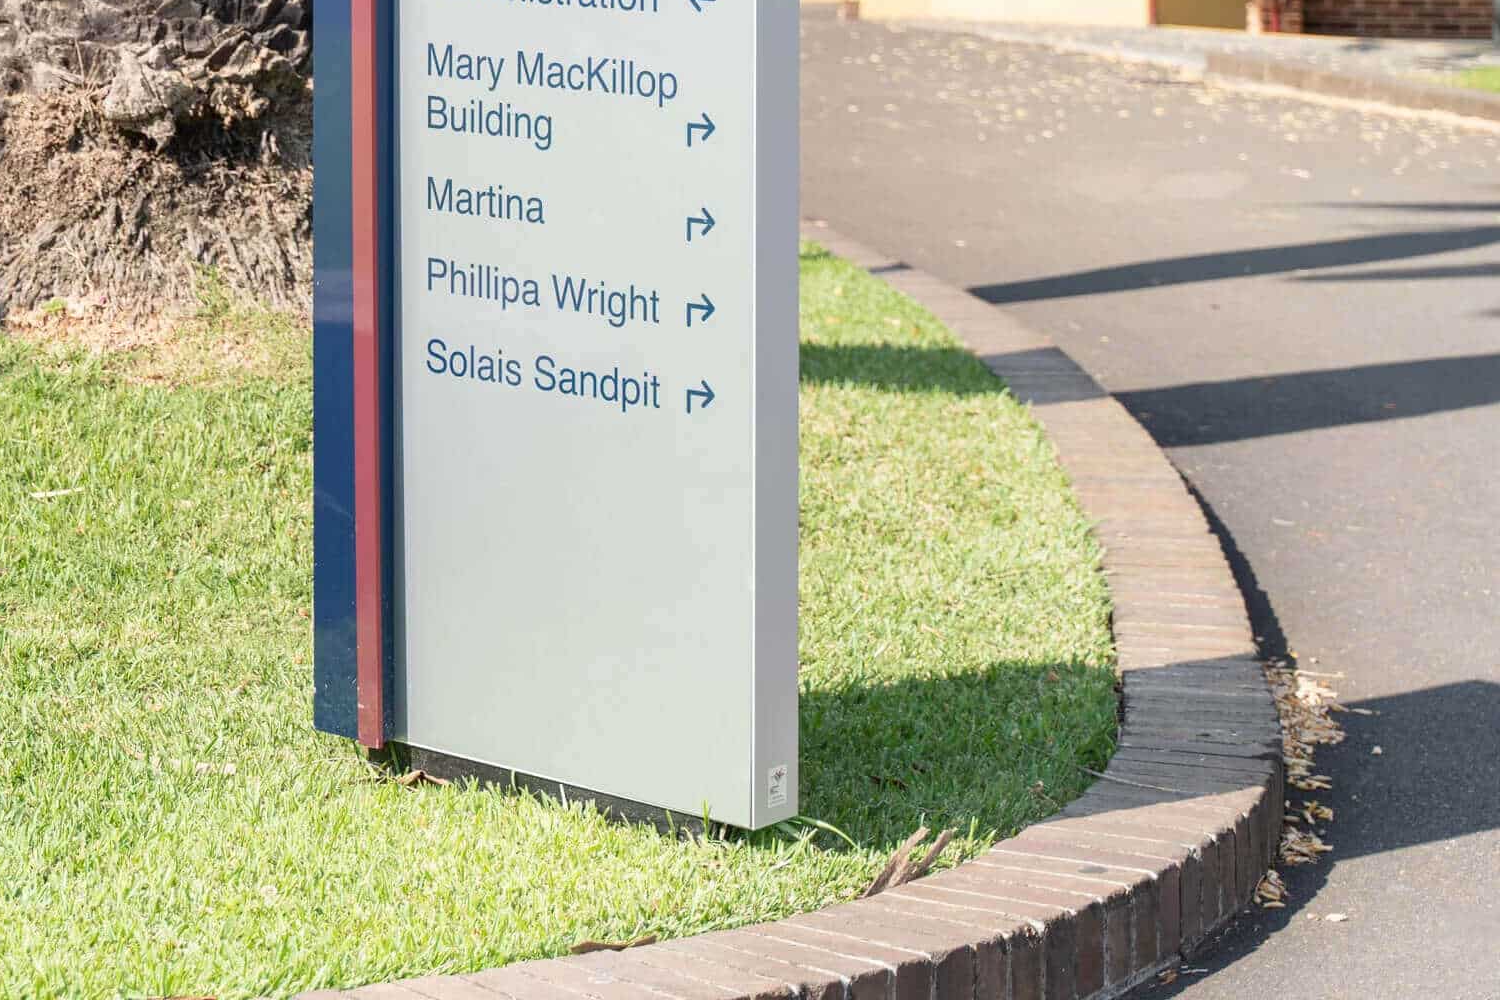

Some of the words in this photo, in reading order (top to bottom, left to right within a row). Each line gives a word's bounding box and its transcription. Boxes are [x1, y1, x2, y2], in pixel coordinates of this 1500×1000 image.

[427, 42, 505, 92] Mary
[517, 50, 678, 108] MacKillop
[427, 95, 552, 151] Building
[427, 176, 545, 225] Martina
[427, 257, 541, 311] Phillipa
[552, 274, 660, 328] Wright
[426, 338, 522, 387] Solais
[534, 355, 661, 413] Sandpit
